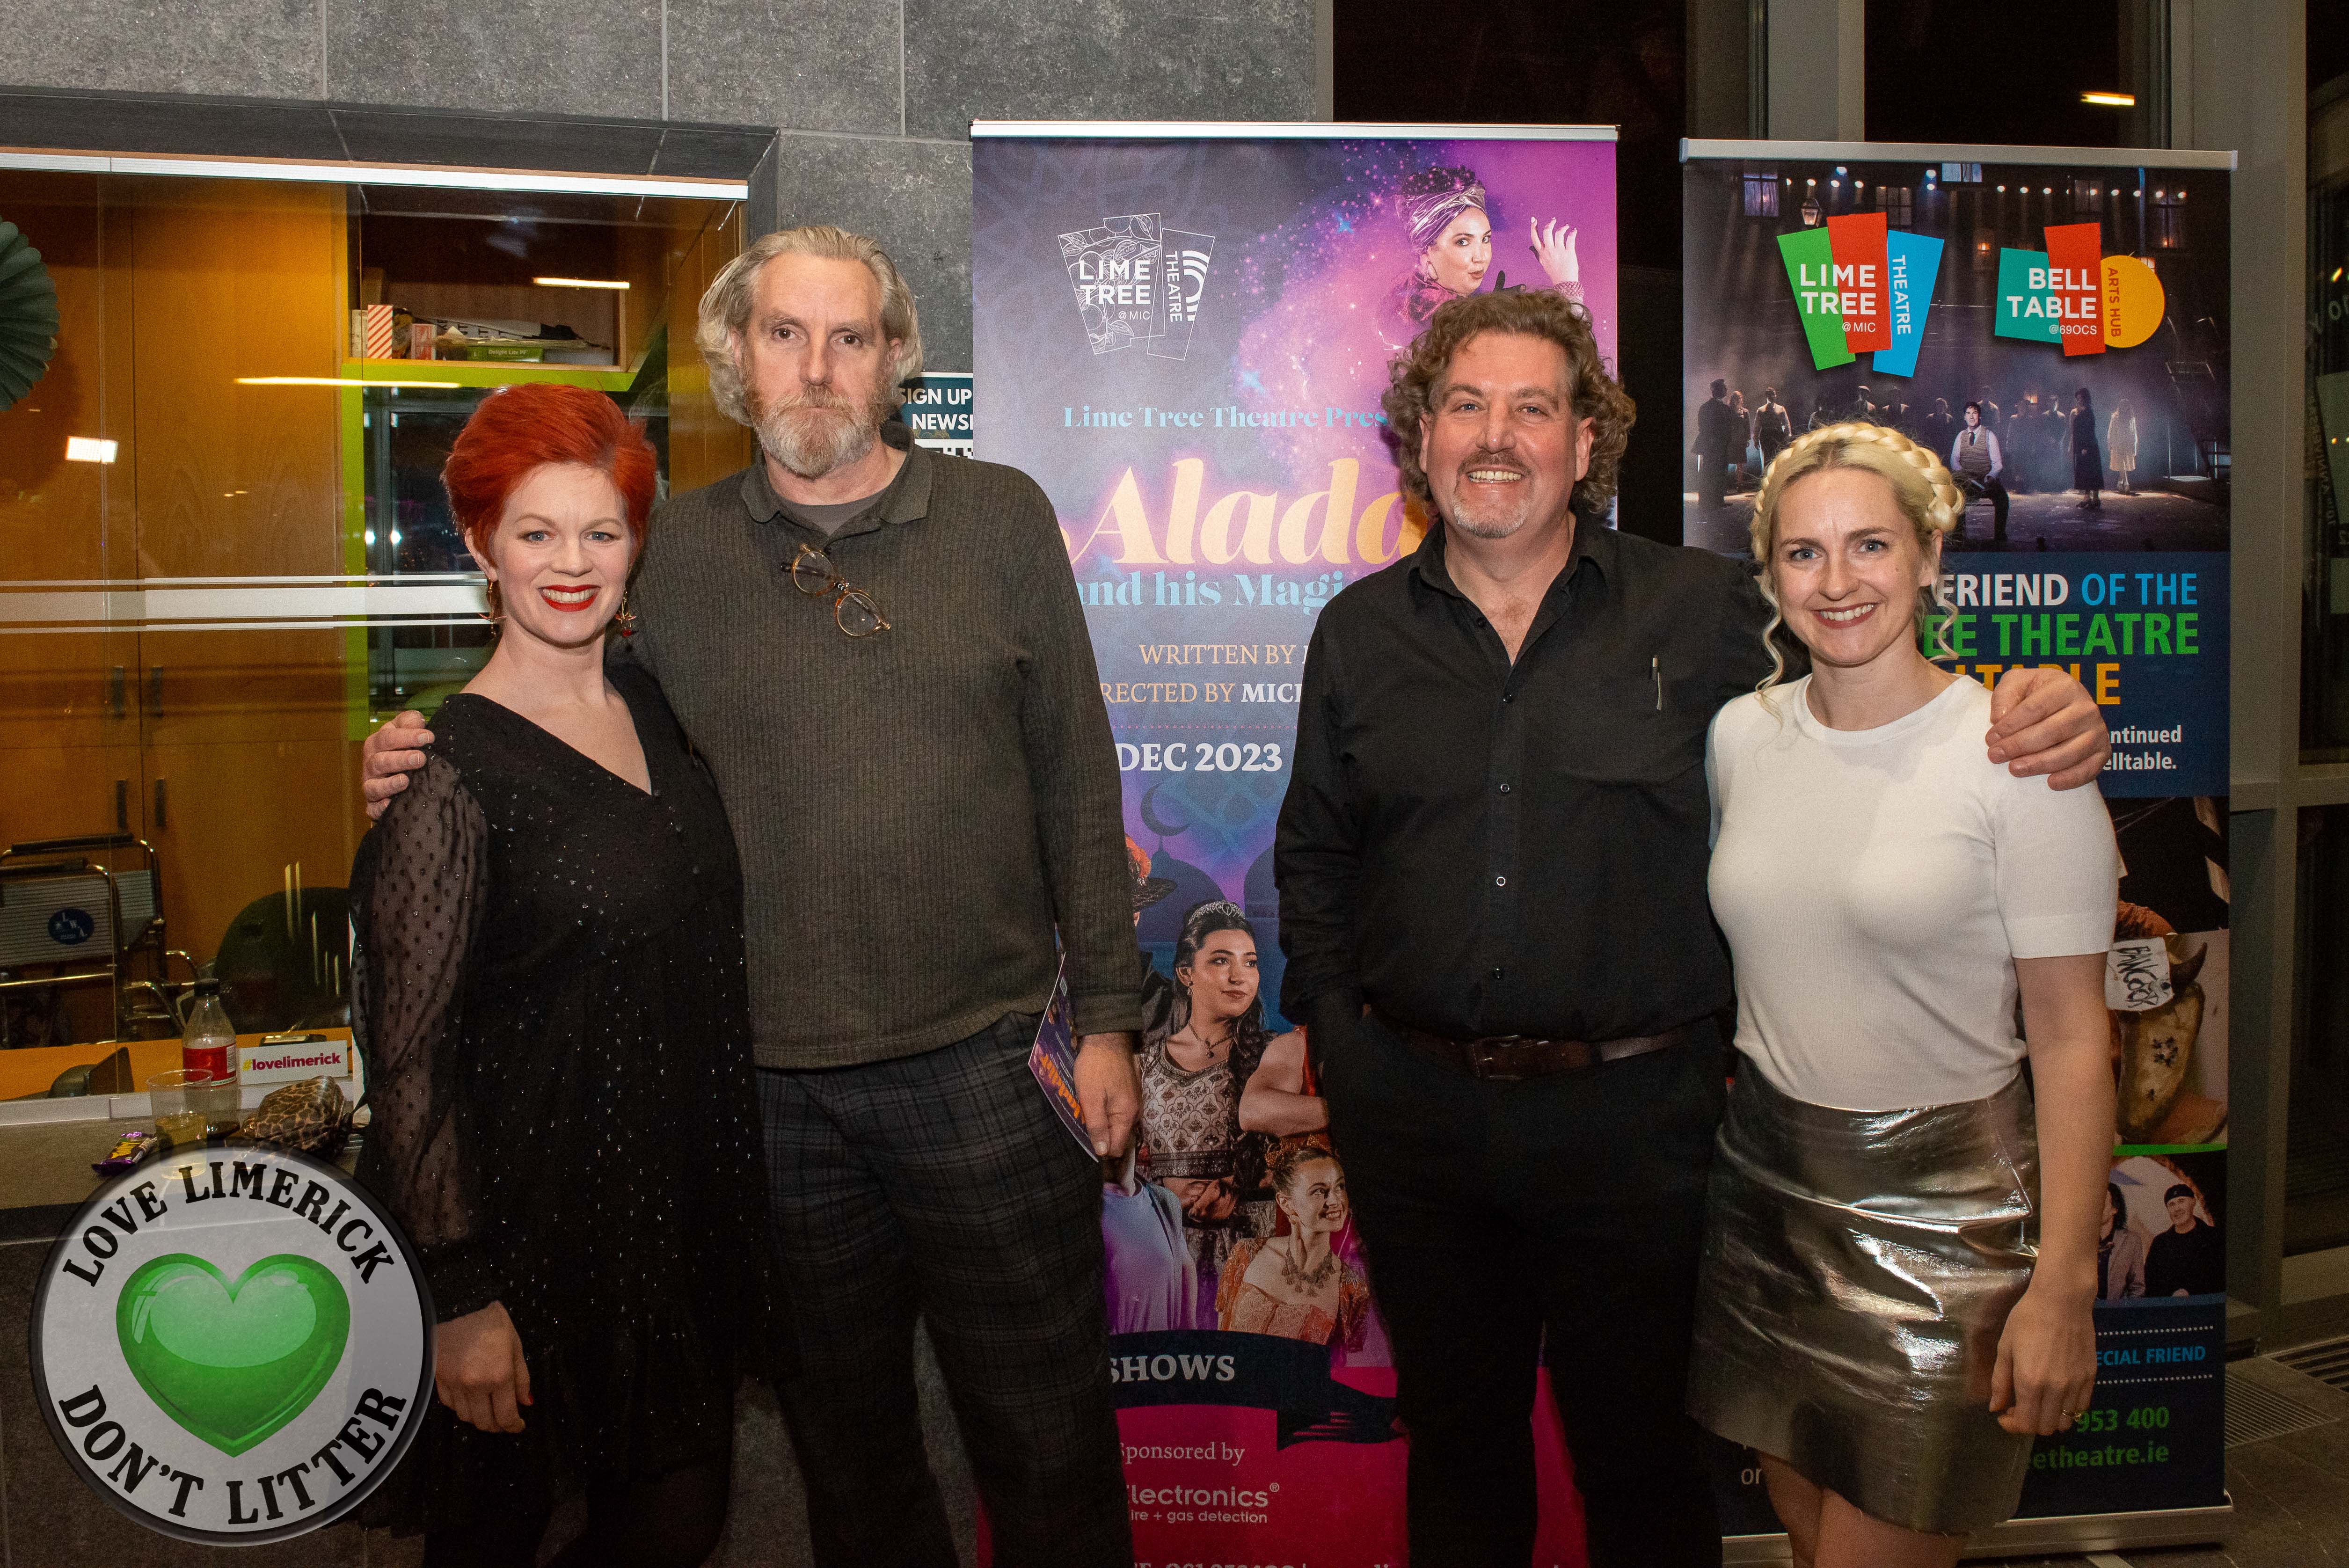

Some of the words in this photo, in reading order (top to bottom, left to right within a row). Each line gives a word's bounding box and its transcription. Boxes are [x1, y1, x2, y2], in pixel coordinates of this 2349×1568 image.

[1079, 259, 1151, 281] LIME
[1800, 263, 1876, 287] LIME
[2028, 268, 2097, 291] BELL
[1079, 284, 1151, 305] TREE
[1166, 251, 1183, 323] THEATRE
[1891, 255, 1911, 335] THEATRE
[2107, 267, 2120, 306] ARTS
[1801, 292, 1876, 315] TREE
[2006, 296, 2097, 319] TABLE
[1118, 311, 1151, 321] @MIC
[1842, 321, 1876, 333] @MIC
[2108, 308, 2122, 338] HUB
[947, 388, 972, 405] UP
[1064, 406, 1132, 428] Lime
[1139, 406, 1204, 428] Tree
[1210, 406, 1319, 428] Theatre
[1155, 570, 1221, 606] his
[1936, 574, 2069, 607] FRIEND
[2081, 573, 2126, 606] OF
[2135, 573, 2197, 605] THE
[1992, 613, 2199, 656] THEATRE
[1138, 644, 1258, 665] WRITTEN
[1265, 644, 1297, 665] BY
[1204, 683, 1236, 703] BY
[1117, 743, 1187, 772] DEC
[1194, 742, 1283, 772] 2023
[242, 1052, 341, 1072] #lovelimerick
[2146, 1345, 2206, 1363] FRIEND
[2126, 1407, 2170, 1429] 400
[1221, 1442, 1246, 1467] by
[1167, 1512, 1194, 1524] gas
[1198, 1510, 1268, 1524] detection
